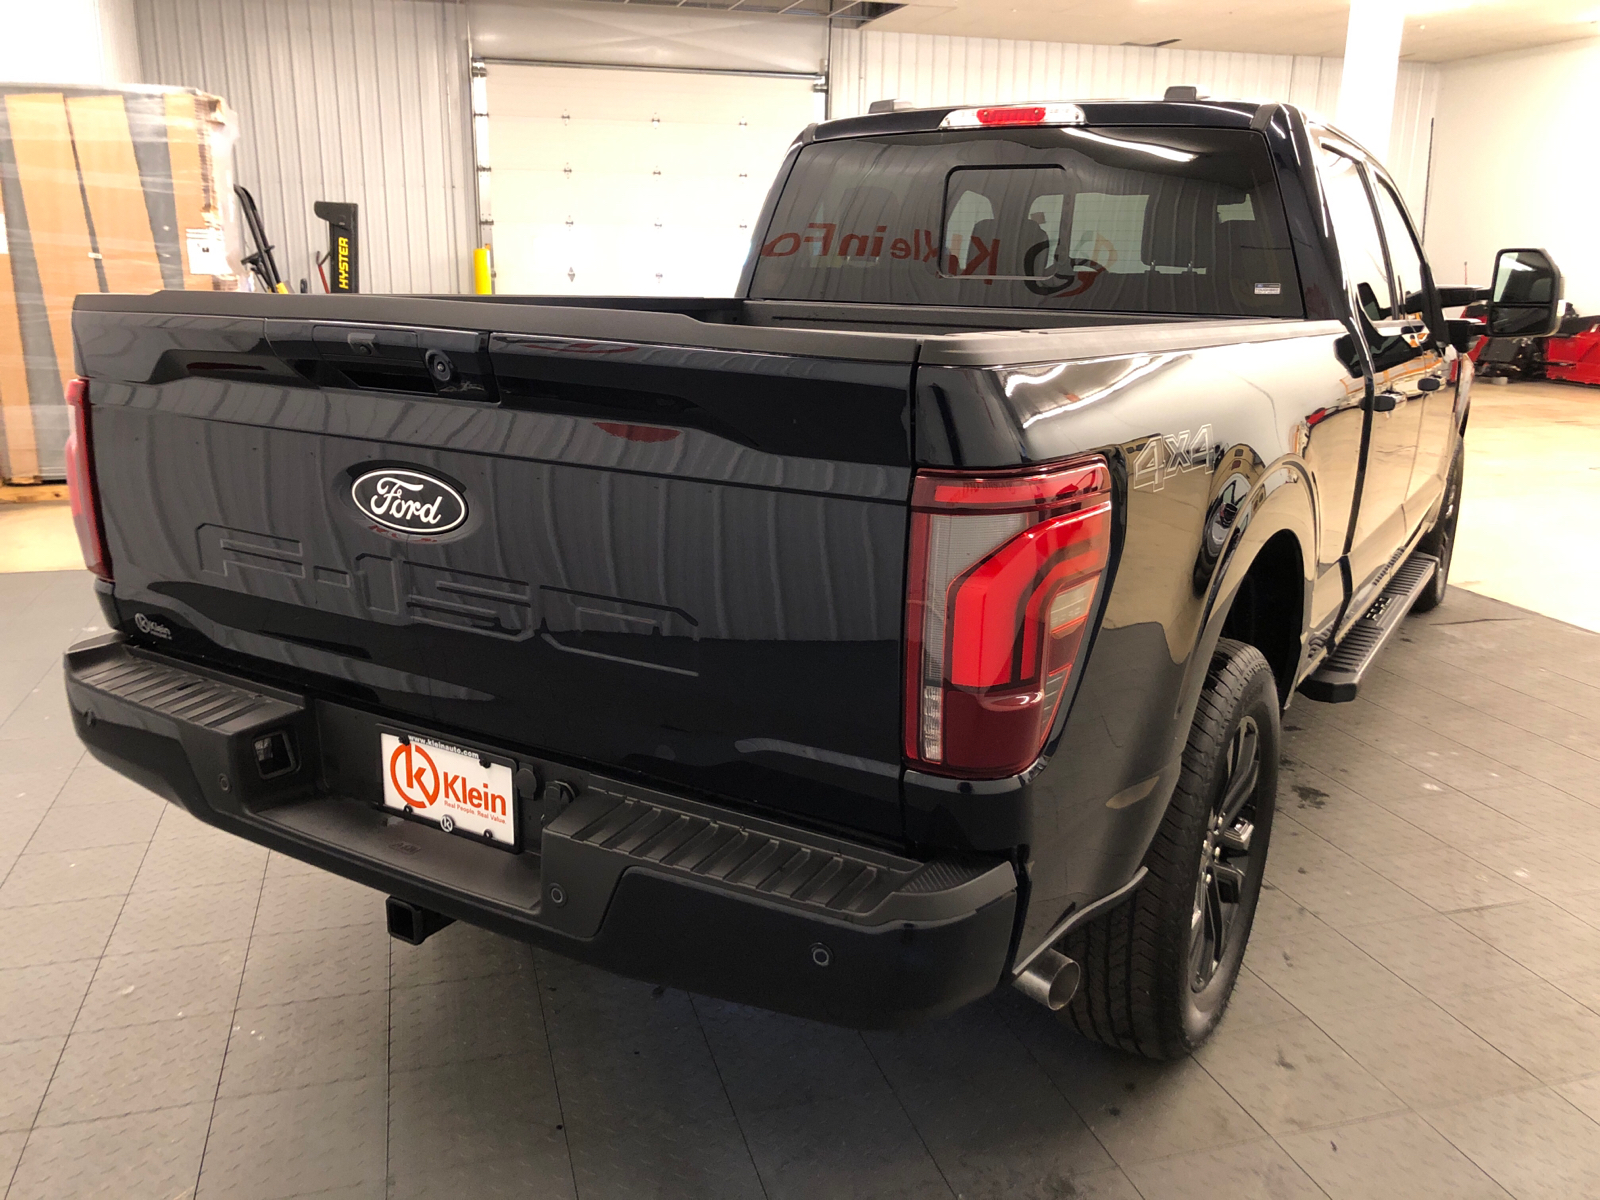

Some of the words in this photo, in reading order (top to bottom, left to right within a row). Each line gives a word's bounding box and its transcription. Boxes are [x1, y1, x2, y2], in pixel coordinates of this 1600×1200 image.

[338, 237, 349, 290] HYSTER
[370, 477, 443, 525] Ford
[197, 522, 699, 678] F-150
[408, 734, 480, 760] www.kleinauto.com
[443, 771, 507, 816] Klein
[444, 800, 456, 809] Real
[457, 804, 476, 816] People.
[477, 810, 489, 819] Real
[490, 814, 507, 825] Value.
